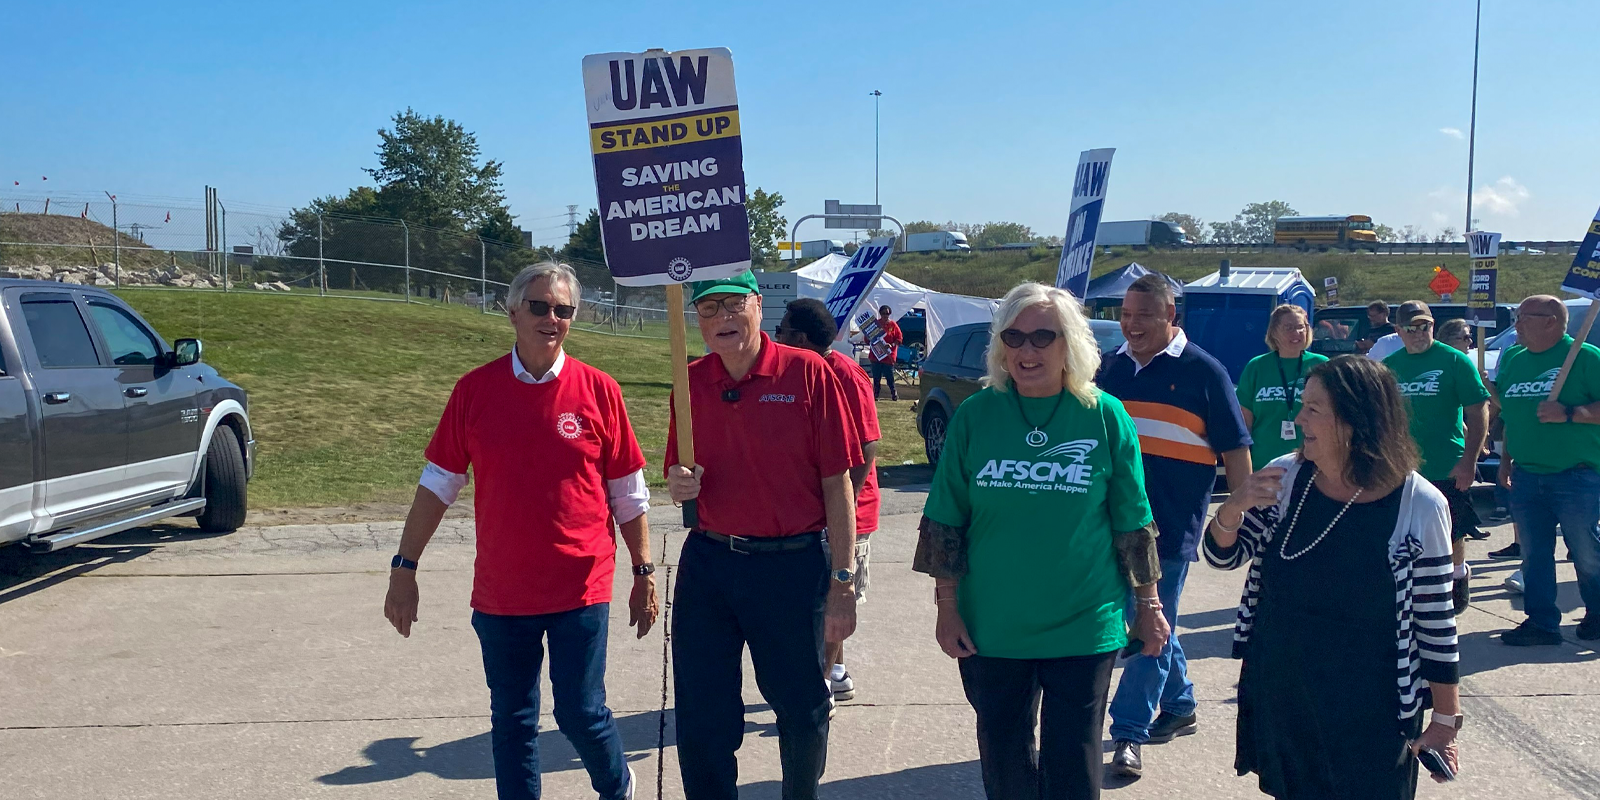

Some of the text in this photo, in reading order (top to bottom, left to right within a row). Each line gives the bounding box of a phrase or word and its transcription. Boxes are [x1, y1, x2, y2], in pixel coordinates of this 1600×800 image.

[608, 55, 708, 111] UAW
[601, 116, 731, 149] STAND UP
[621, 157, 719, 187] SAVING
[662, 184, 680, 193] THE
[606, 185, 741, 221] AMERICAN
[630, 212, 721, 241] DREAM
[1484, 260, 1496, 268] UP
[856, 311, 871, 324] UAW
[976, 459, 1093, 486] AFSCME
[989, 480, 1013, 488] Make
[1014, 481, 1052, 490] America
[1054, 483, 1088, 494] Happen
